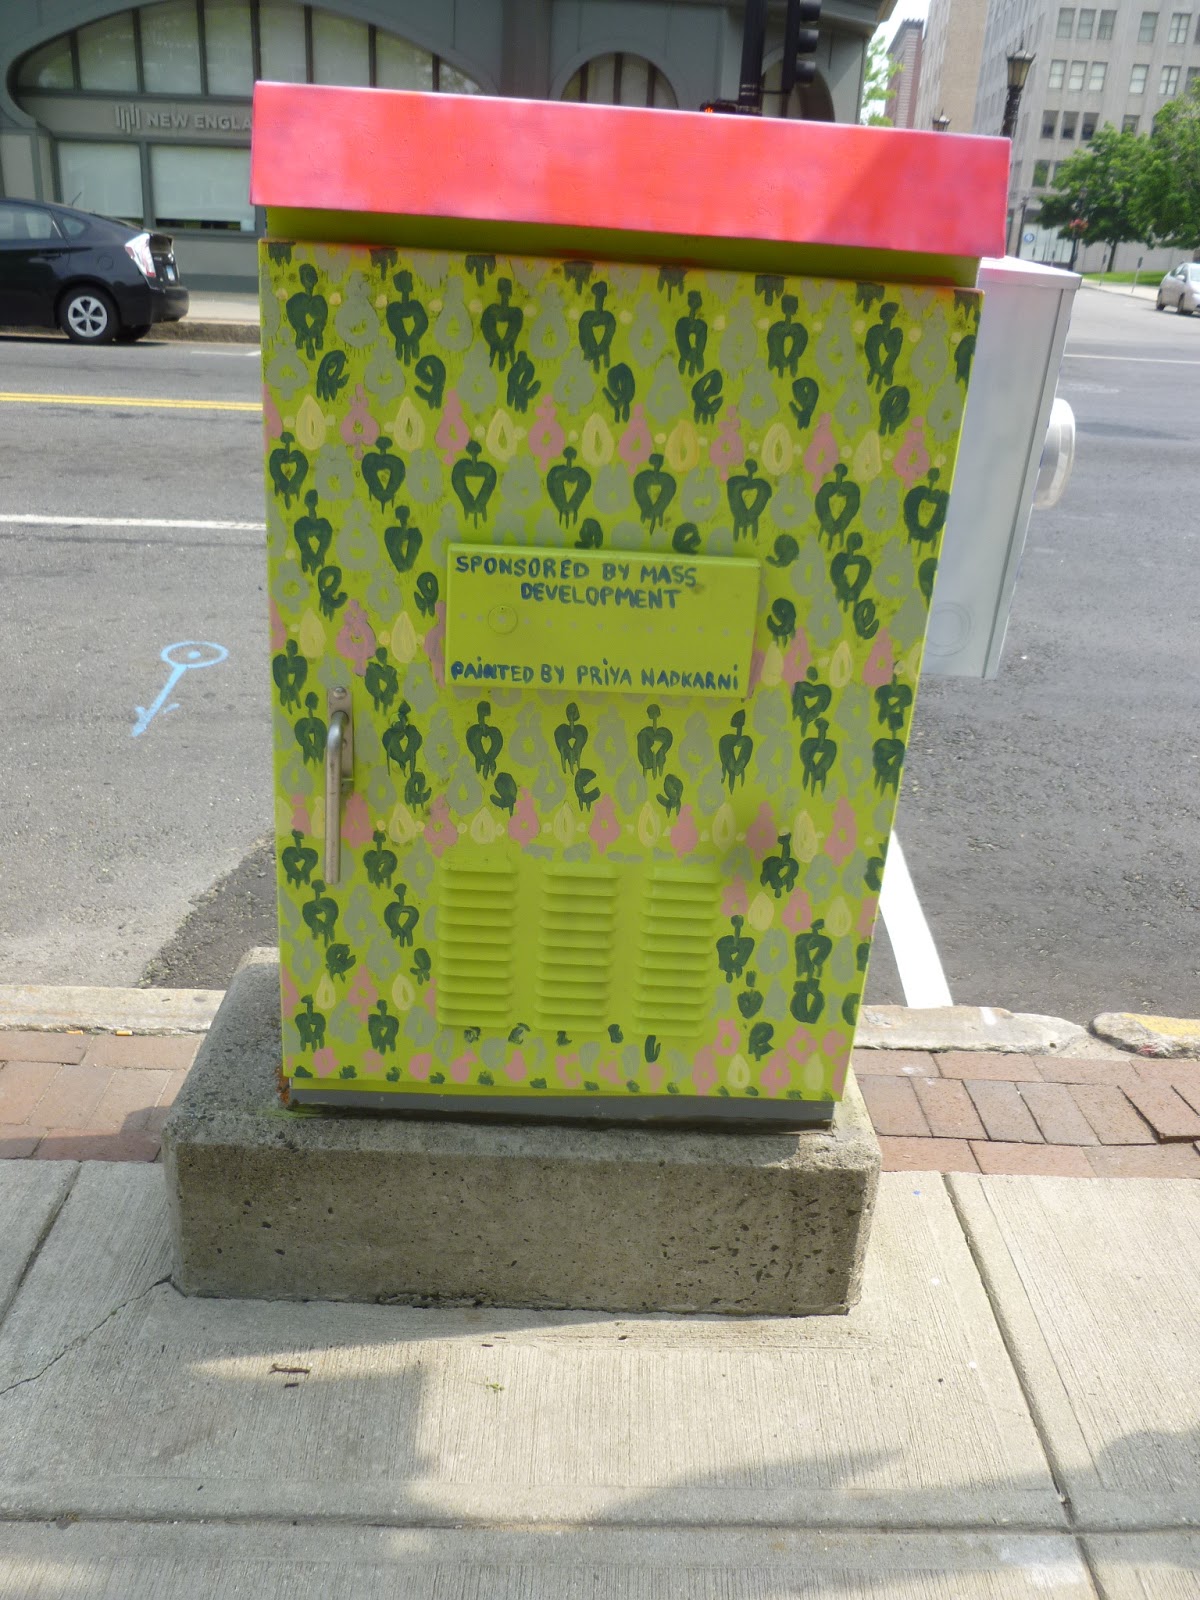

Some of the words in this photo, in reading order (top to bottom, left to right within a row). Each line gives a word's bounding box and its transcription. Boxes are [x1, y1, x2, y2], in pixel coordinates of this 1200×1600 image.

[146, 111, 189, 128] NEW
[455, 555, 590, 579] SPONSORED
[602, 562, 630, 581] BY
[640, 564, 698, 588] MASS
[520, 582, 682, 609] DEVELOPMENT
[540, 663, 565, 684] BY
